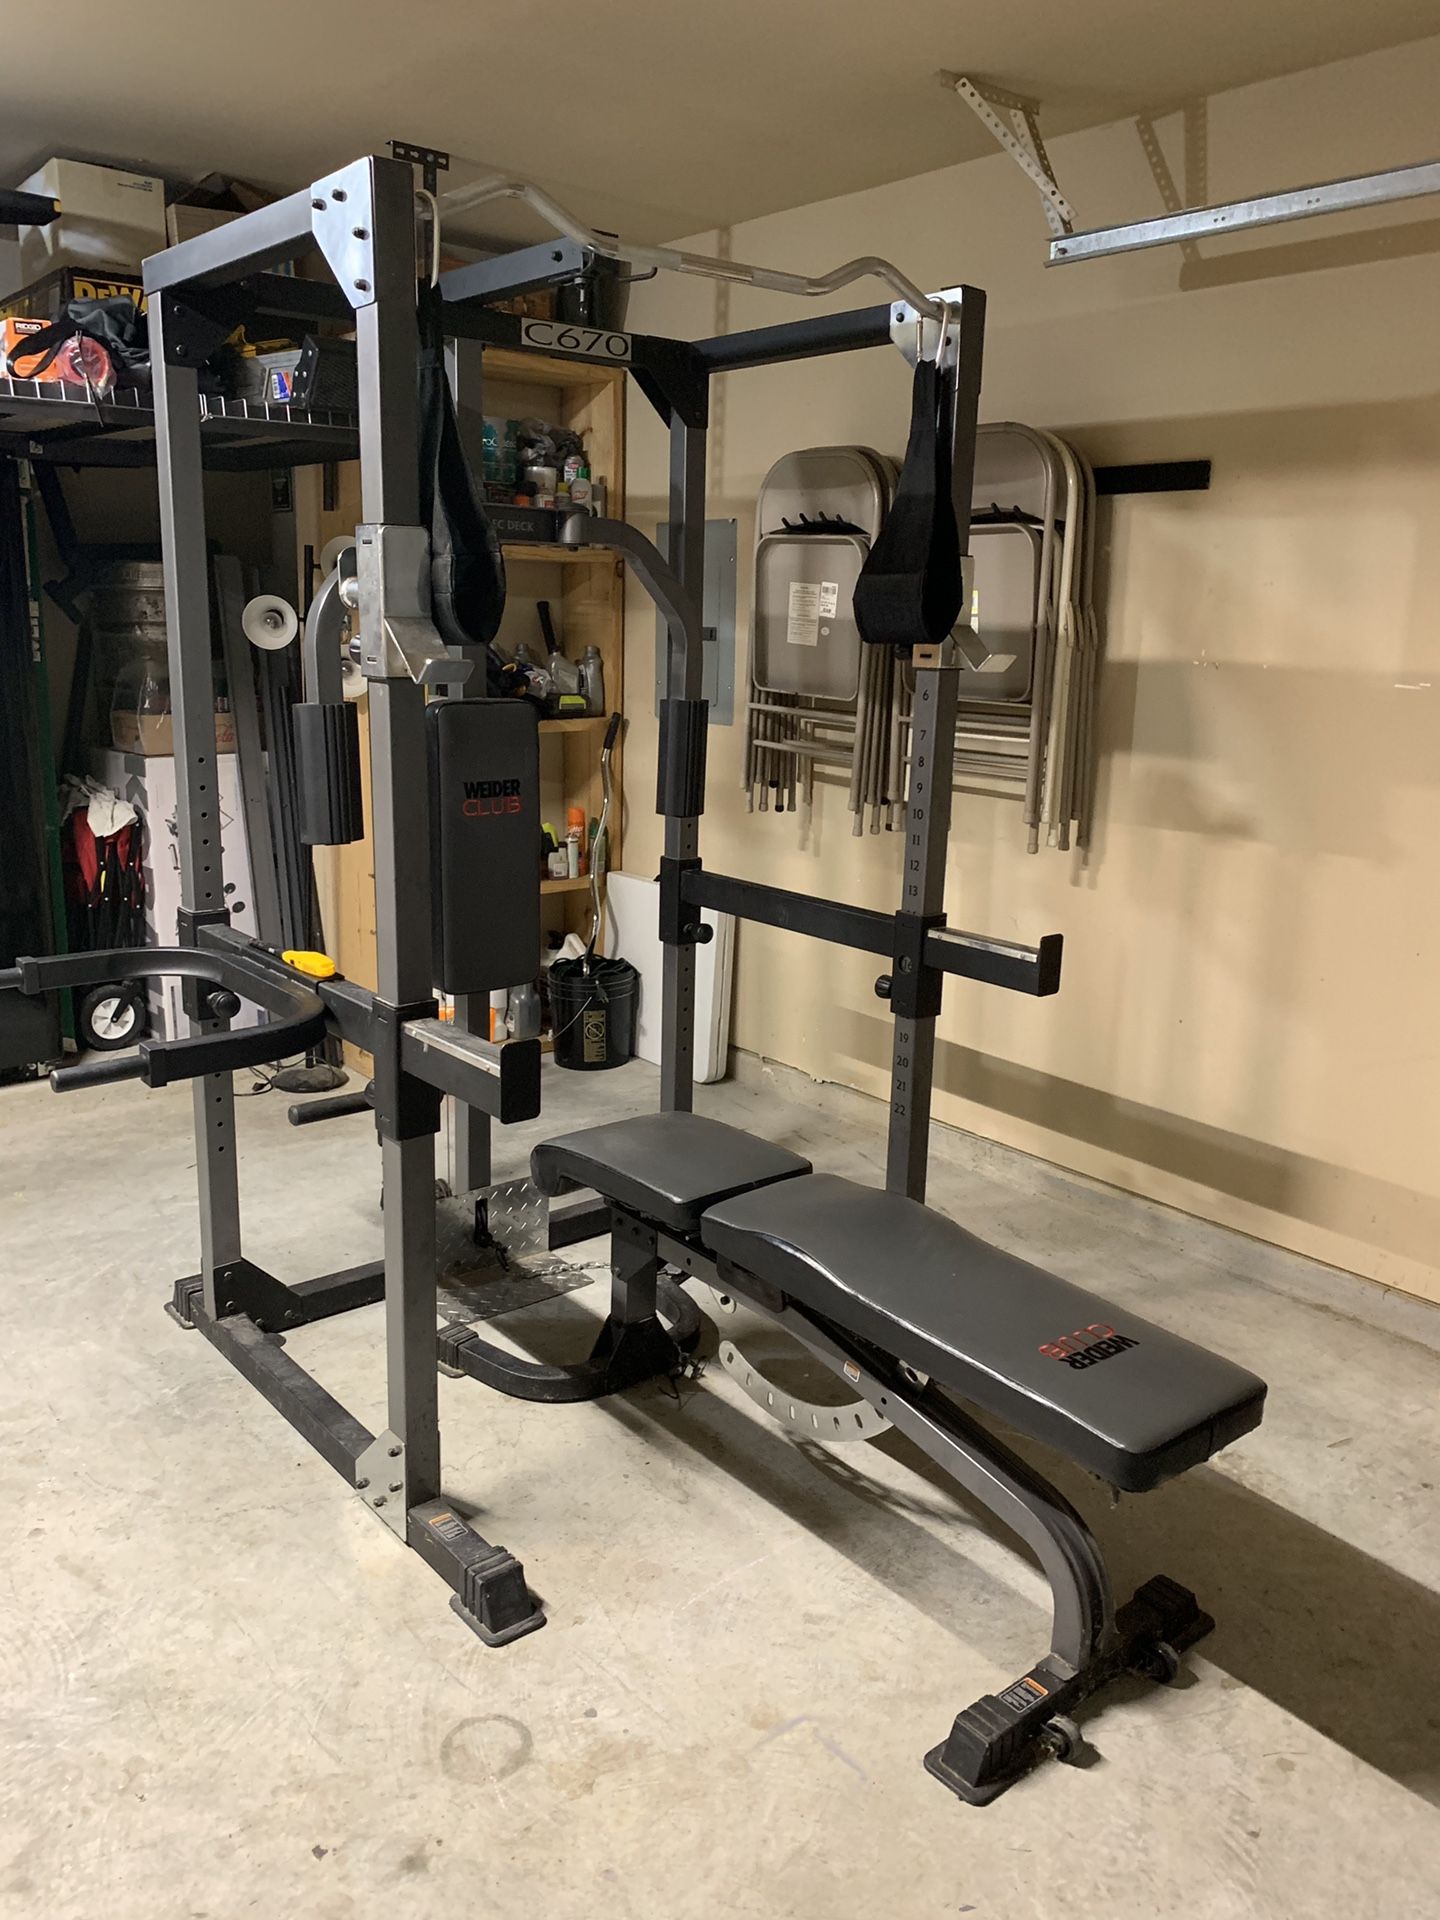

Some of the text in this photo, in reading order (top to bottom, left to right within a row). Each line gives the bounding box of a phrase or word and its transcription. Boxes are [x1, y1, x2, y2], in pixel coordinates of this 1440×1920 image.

[73, 280, 147, 314] DEW
[524, 322, 629, 357] C670
[507, 520, 534, 532] DECK
[922, 689, 929, 700] 6
[920, 729, 927, 740] 7
[918, 756, 925, 768] 8
[463, 779, 521, 799] WEIDER
[916, 782, 923, 794] 9
[463, 796, 522, 816] CLUB
[913, 808, 923, 820] 10
[912, 834, 920, 846] 11
[910, 860, 920, 872] 12
[908, 885, 918, 897] 13
[899, 1031, 909, 1043] 19
[897, 1055, 909, 1068] 20
[896, 1079, 906, 1091] 21
[894, 1103, 905, 1115] 22
[1039, 1324, 1115, 1360] CLUB
[1058, 1335, 1140, 1370] WEIDER
